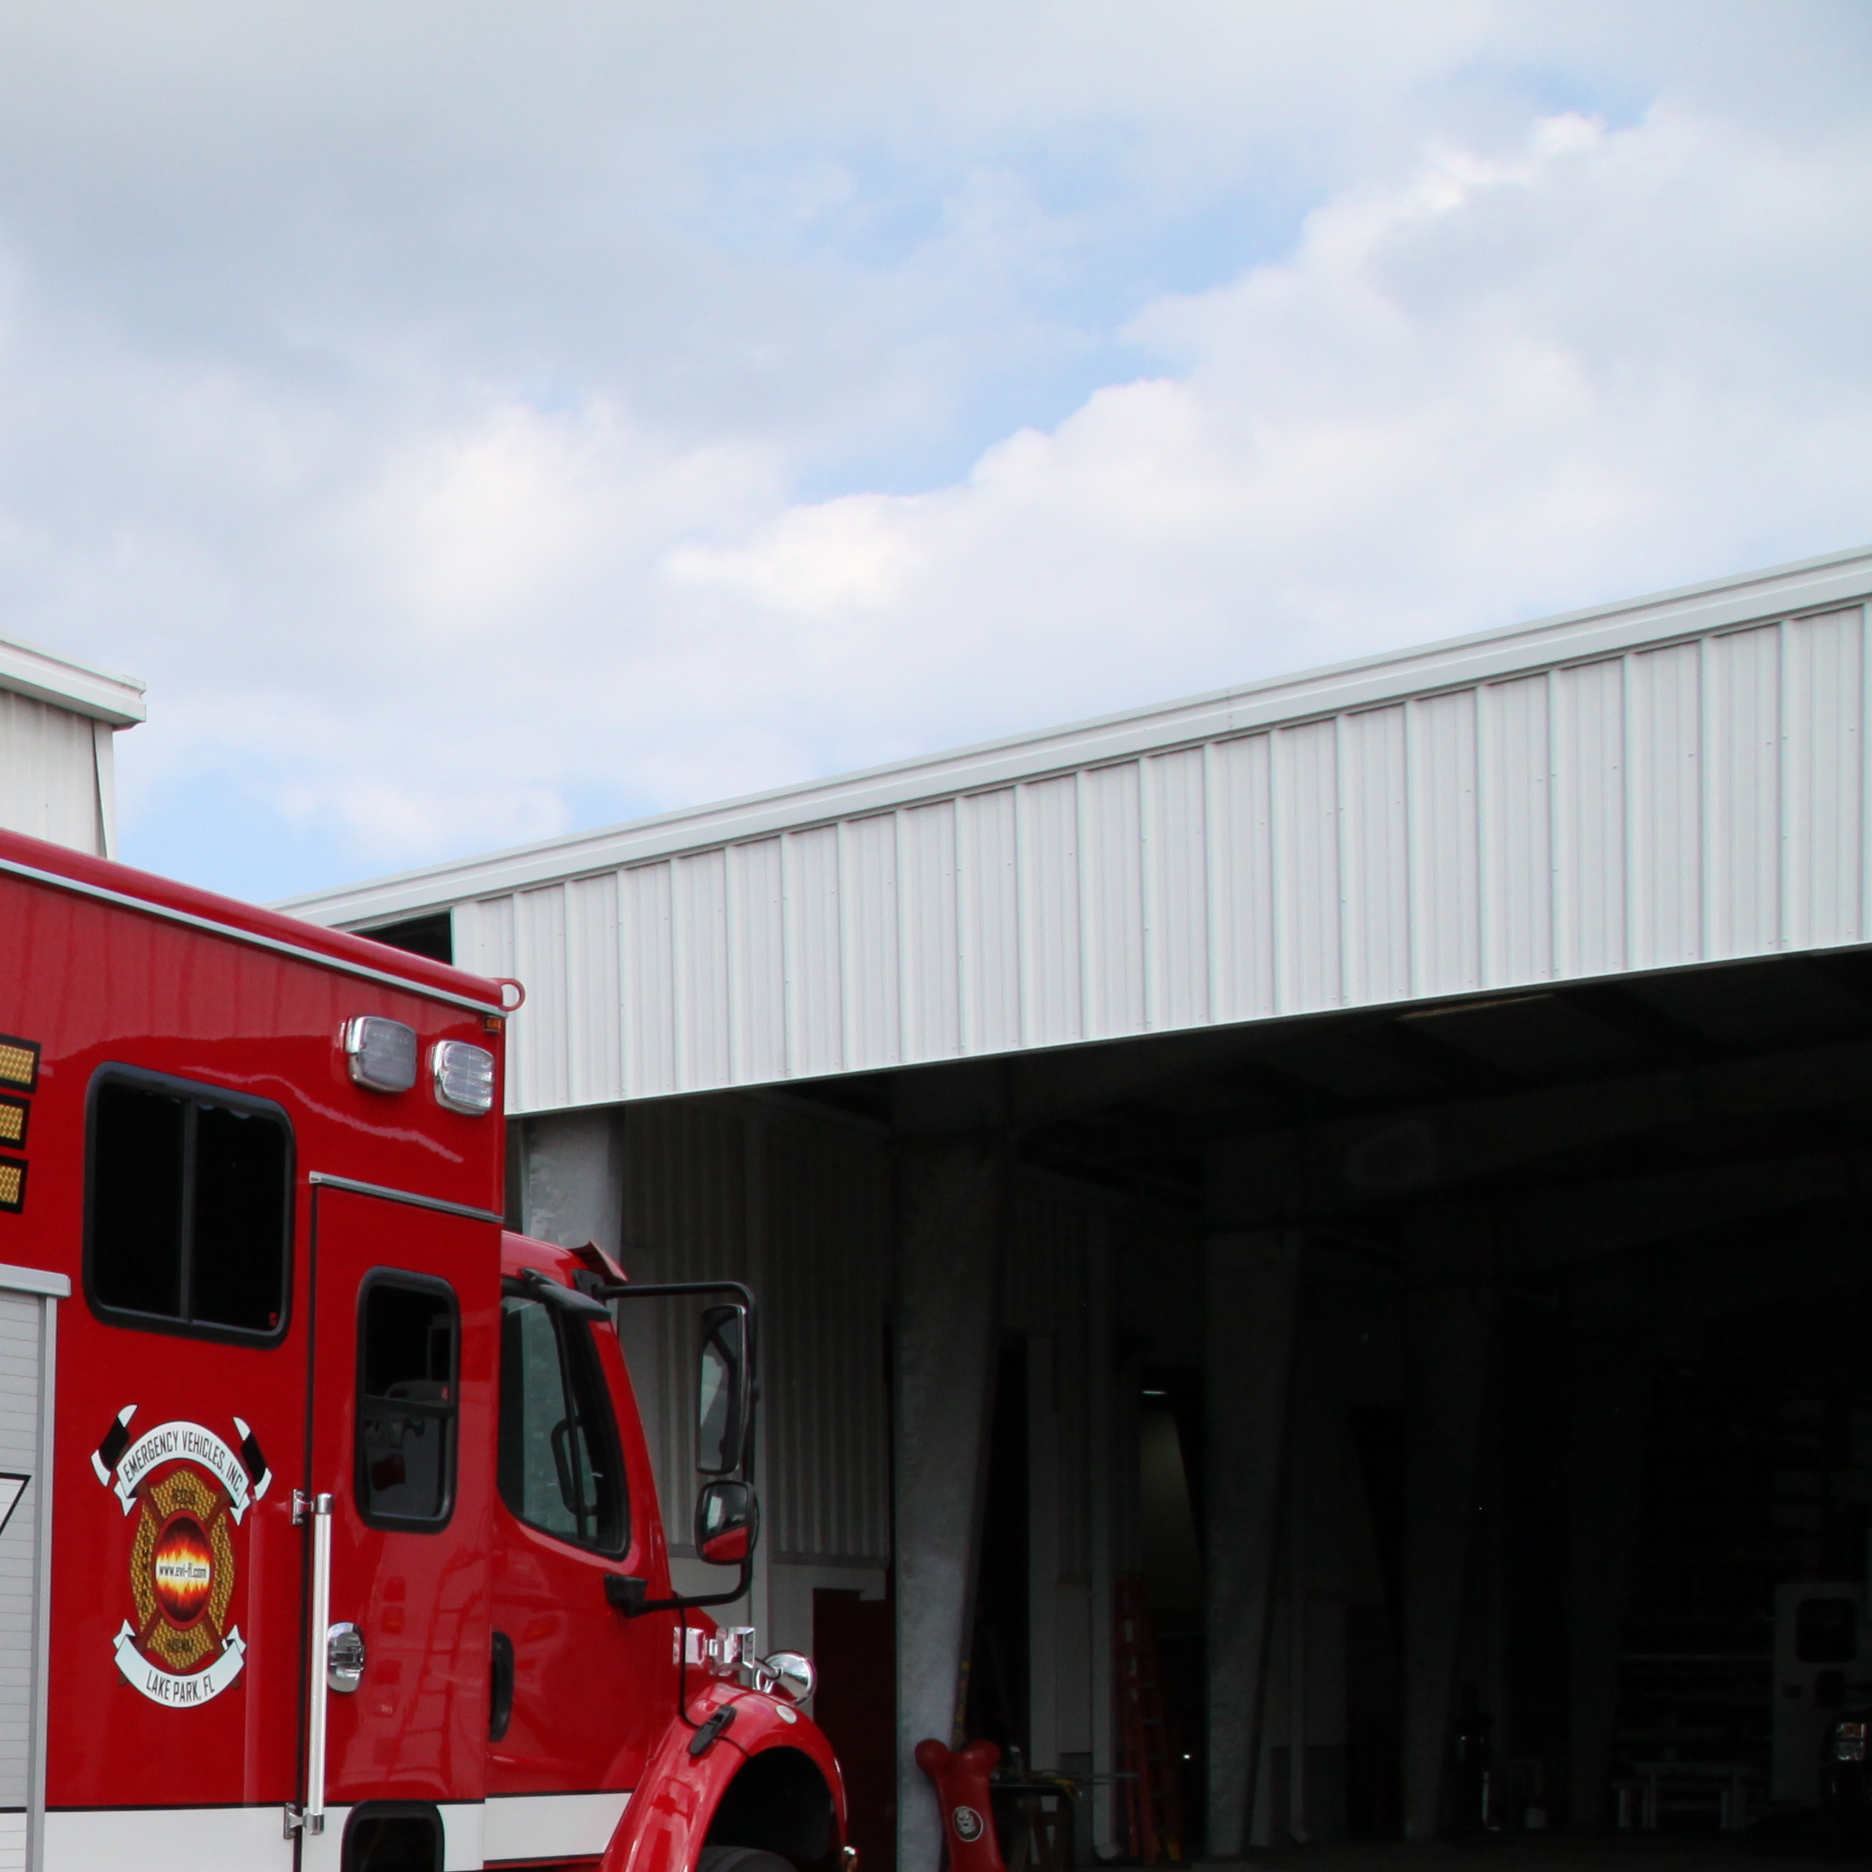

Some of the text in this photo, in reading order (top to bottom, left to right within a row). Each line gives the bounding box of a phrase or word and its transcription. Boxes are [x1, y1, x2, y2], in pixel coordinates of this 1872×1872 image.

[123, 1430, 244, 1496] EMERGENCY VEHICLES, INC.
[146, 1670, 215, 1702] LAKE PARK, FL
